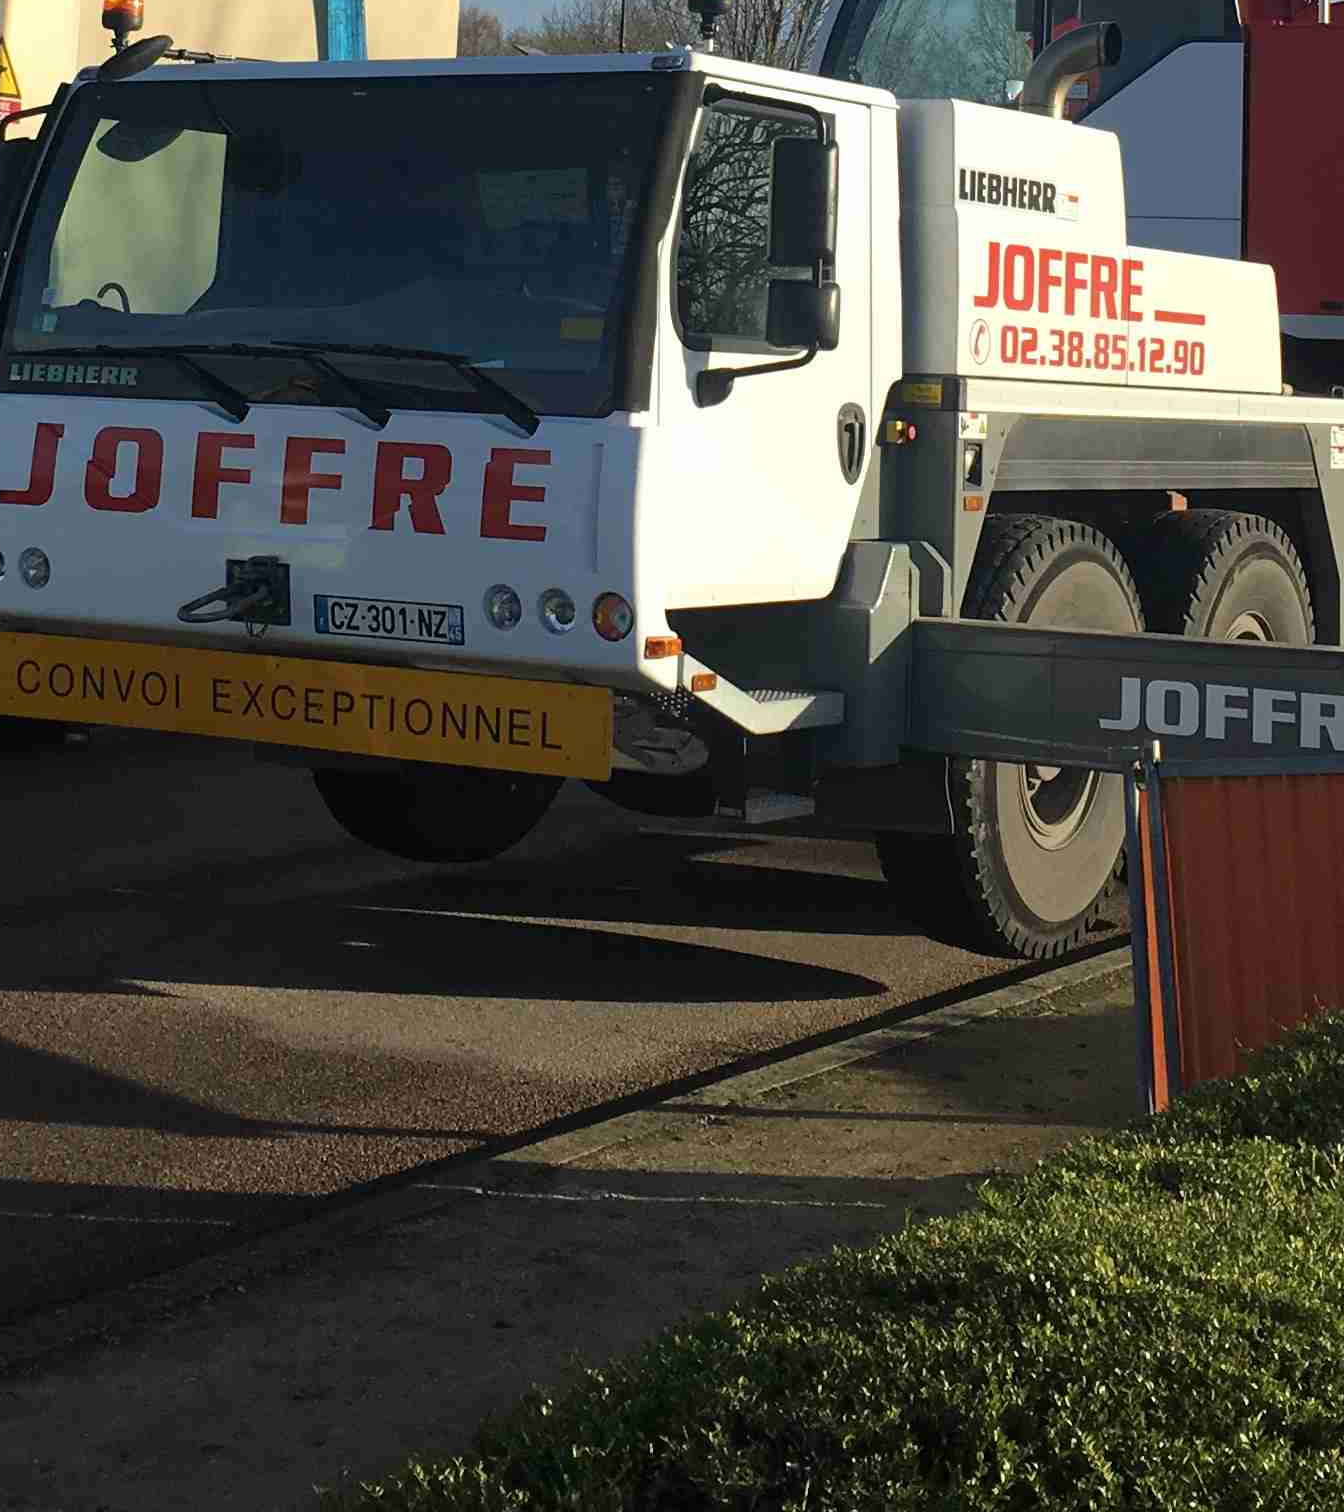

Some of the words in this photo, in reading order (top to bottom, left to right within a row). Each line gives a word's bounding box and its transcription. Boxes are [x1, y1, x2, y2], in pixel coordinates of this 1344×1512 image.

[958, 167, 1057, 215] LIEBHERR
[973, 240, 1144, 322] JOFFRE
[8, 361, 139, 387] LIEBHERR
[999, 324, 1206, 376] 02.38.85.12.90
[16, 659, 182, 711] CONVOI
[211, 678, 564, 751] EXCEPTIONNEL
